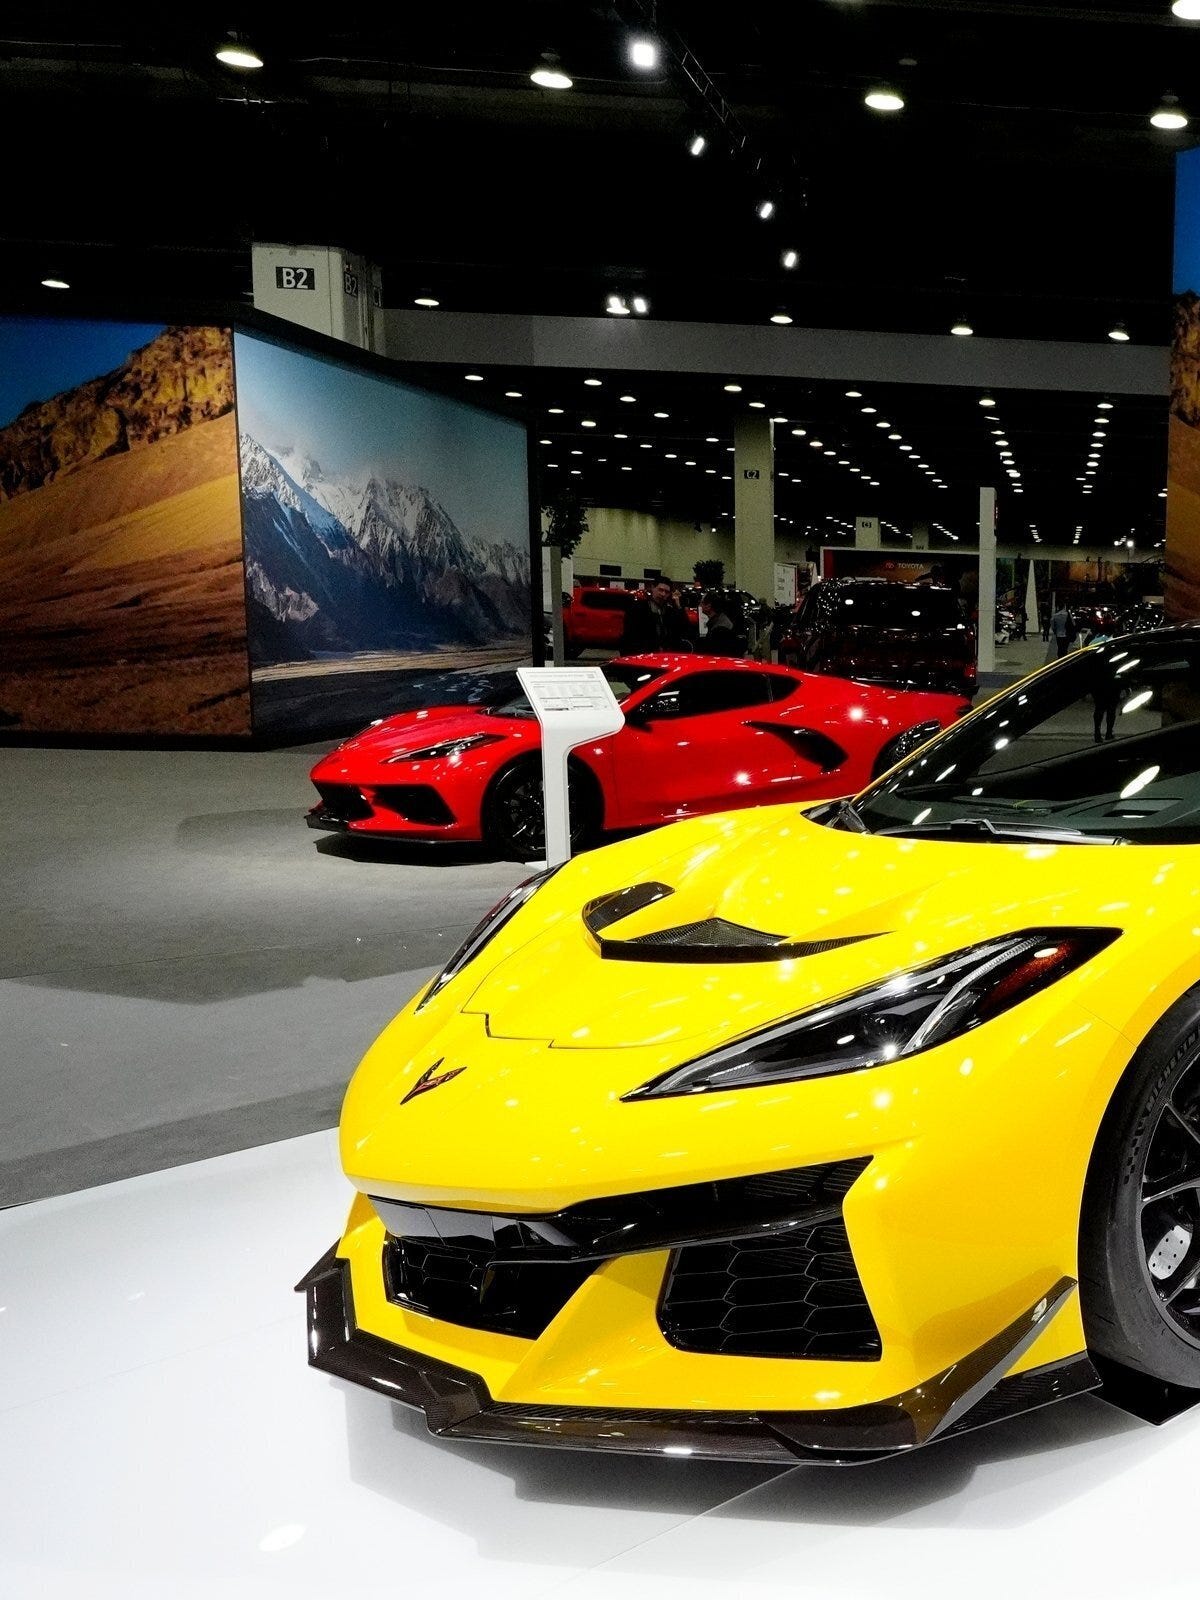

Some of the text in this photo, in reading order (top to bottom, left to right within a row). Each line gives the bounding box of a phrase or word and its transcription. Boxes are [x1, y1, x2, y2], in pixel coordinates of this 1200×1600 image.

[282, 267, 308, 289] B2
[345, 273, 357, 296] B2
[1145, 1028, 1198, 1112] MICHELIN
